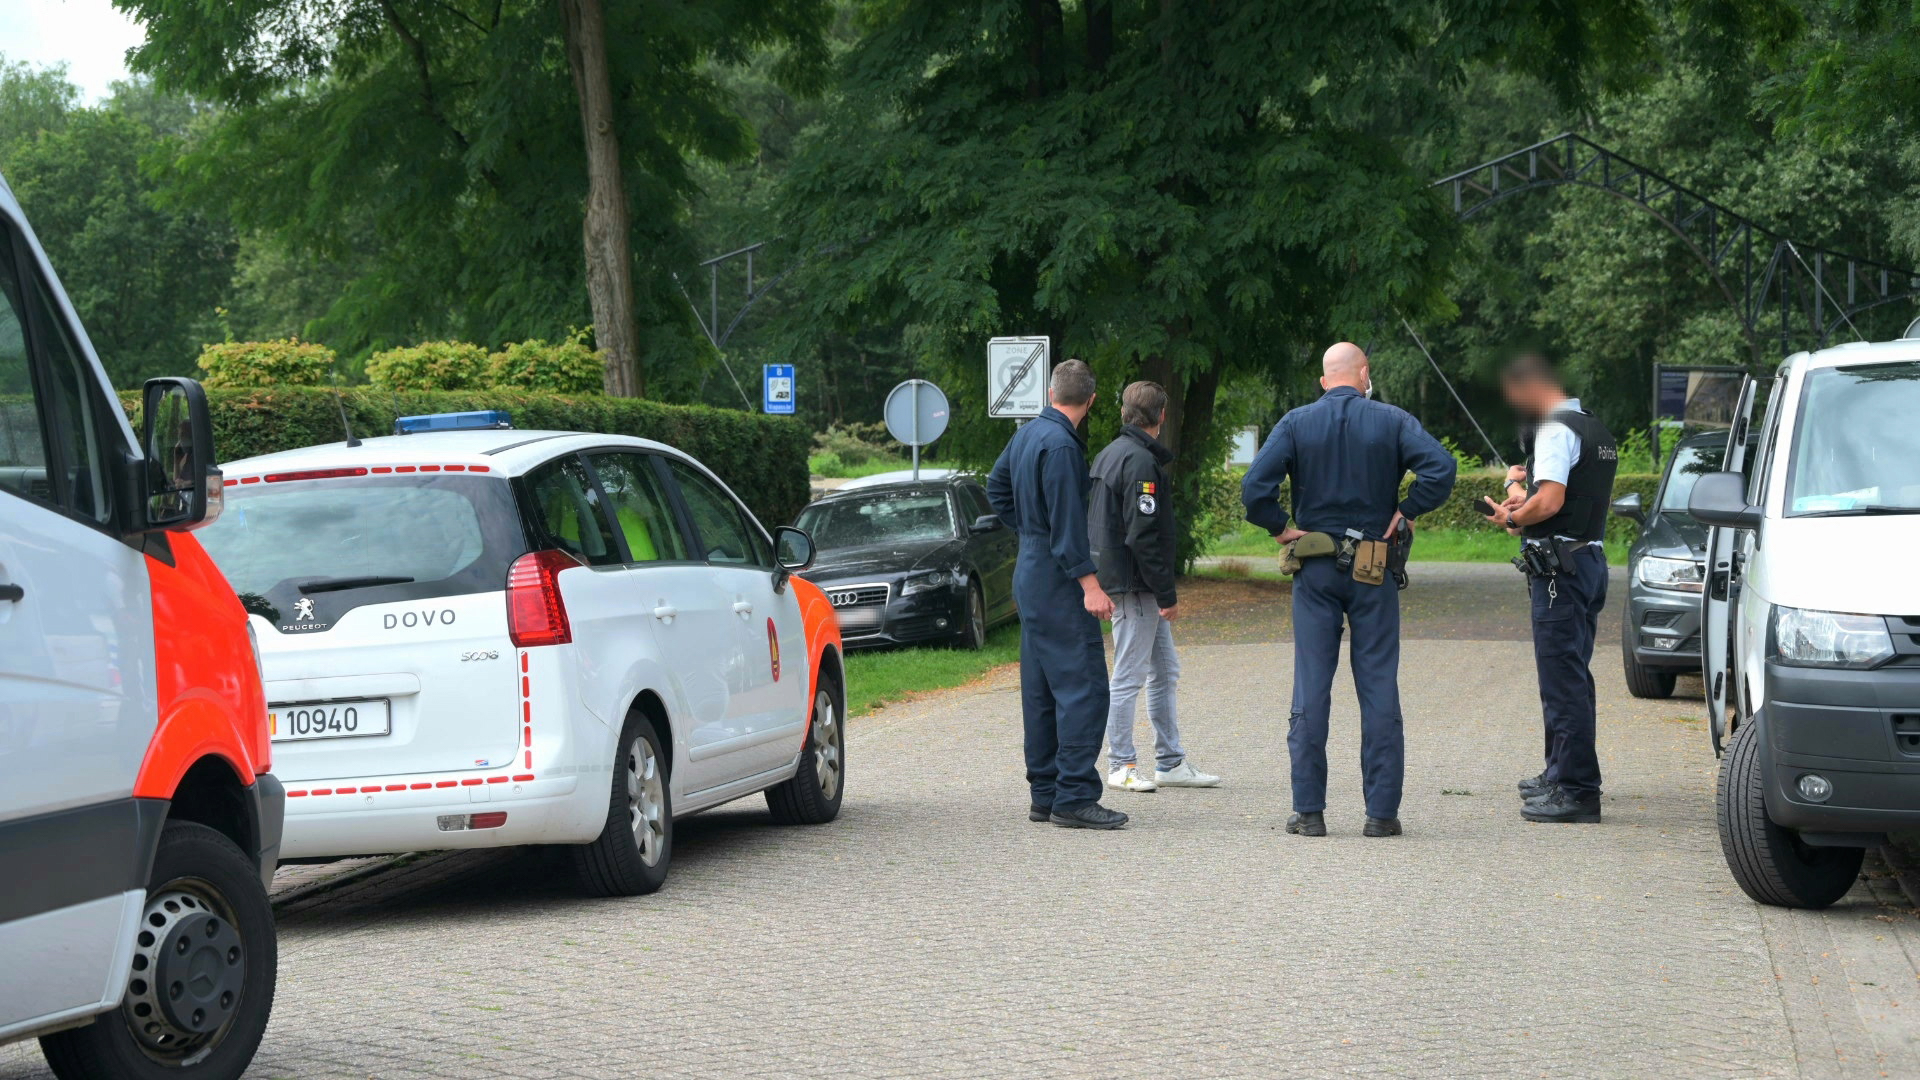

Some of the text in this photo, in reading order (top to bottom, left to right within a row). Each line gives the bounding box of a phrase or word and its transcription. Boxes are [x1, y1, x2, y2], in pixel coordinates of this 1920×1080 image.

[1006, 346, 1028, 354] ZONE
[1598, 446, 1616, 459] Politie
[383, 609, 456, 630] DOVO
[282, 623, 327, 631] PEUGEOT
[286, 707, 358, 736] 10940
